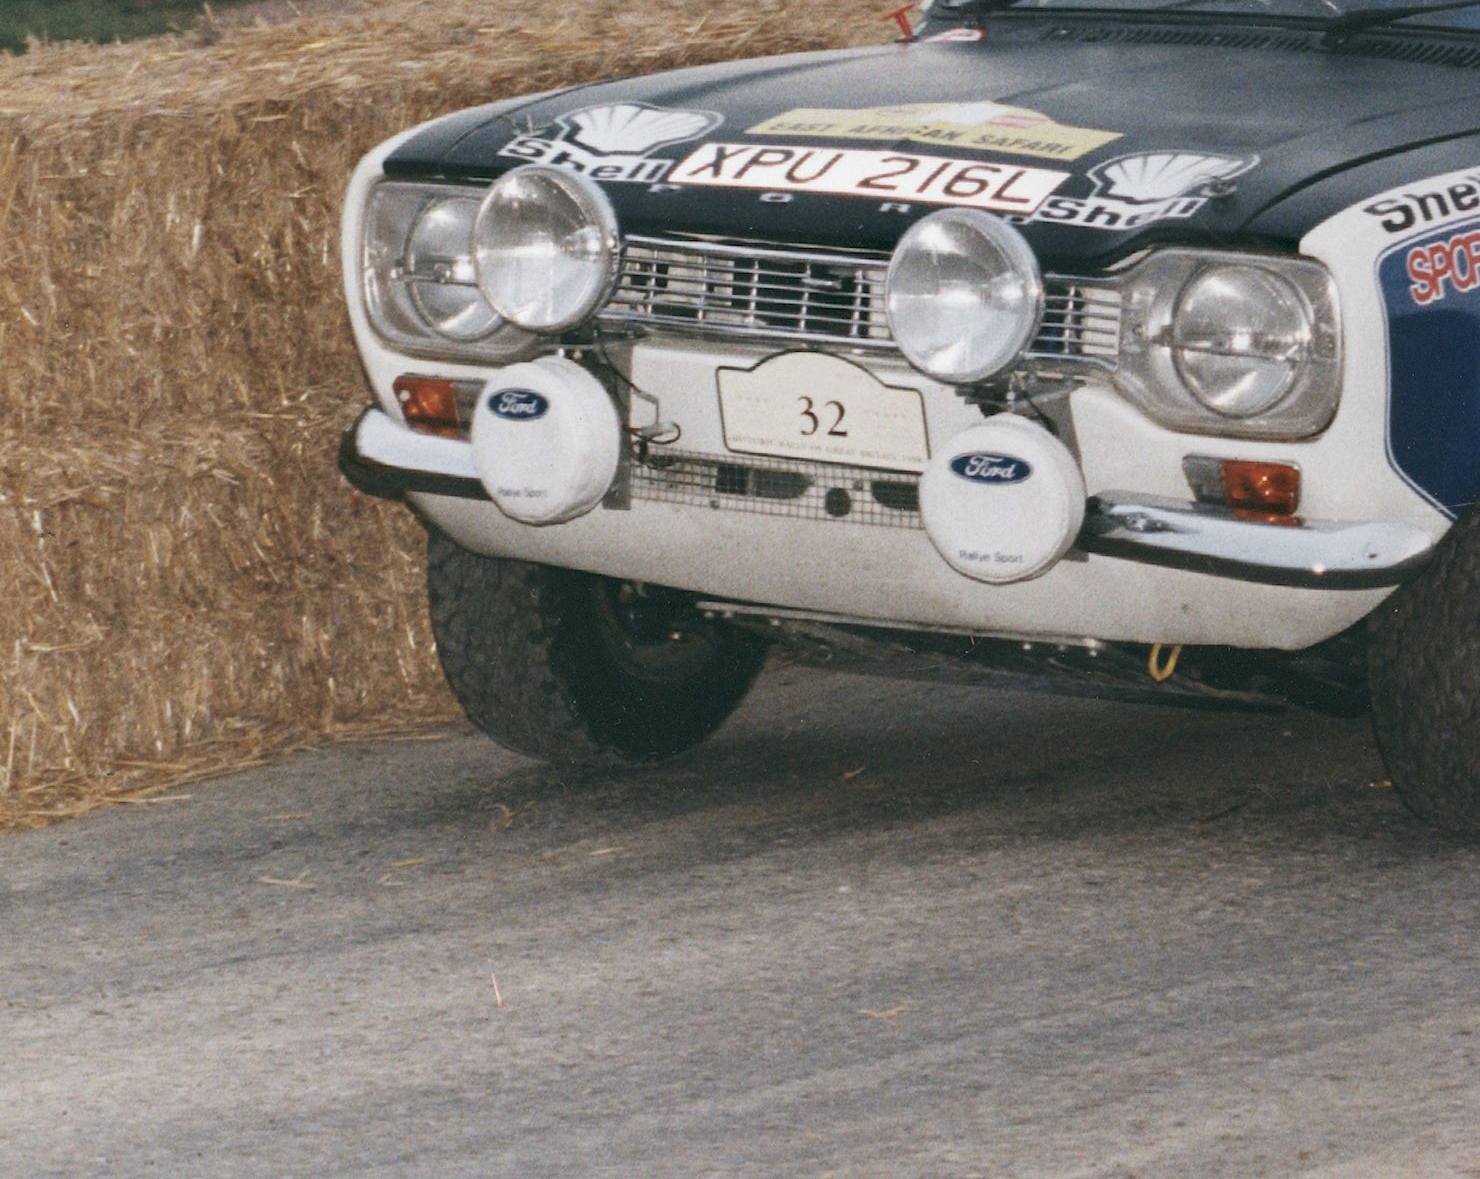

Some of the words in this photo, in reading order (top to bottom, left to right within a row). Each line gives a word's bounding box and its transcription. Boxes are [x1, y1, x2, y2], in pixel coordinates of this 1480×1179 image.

[972, 134, 1074, 154] SAFARI
[506, 137, 664, 181] Shell
[687, 146, 845, 184] XPU
[855, 156, 1040, 204] 216L
[498, 392, 538, 414] Ford
[798, 396, 848, 438] 32
[964, 454, 1017, 479] Ford
[994, 551, 1024, 563] Sport
